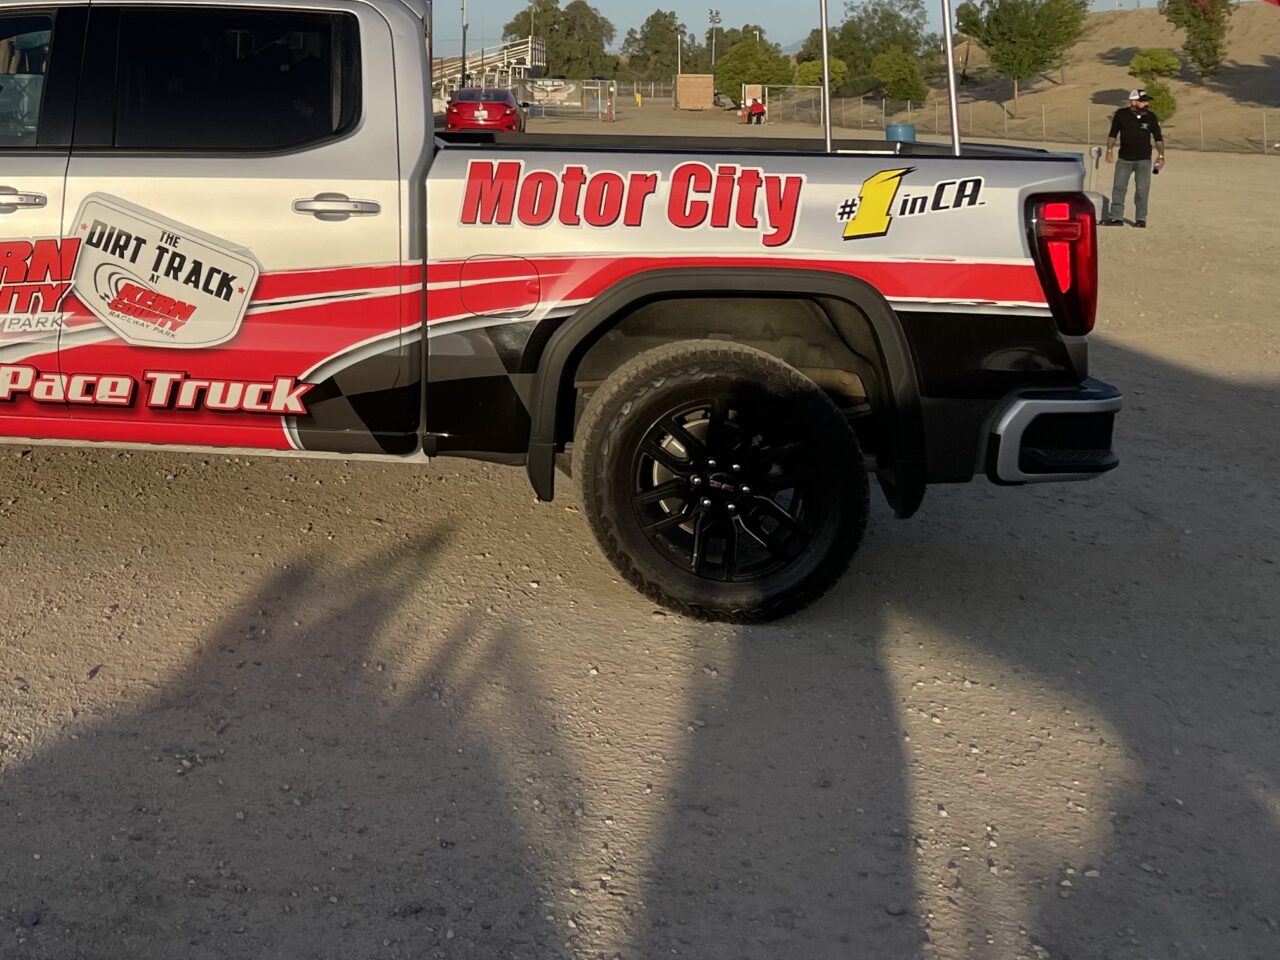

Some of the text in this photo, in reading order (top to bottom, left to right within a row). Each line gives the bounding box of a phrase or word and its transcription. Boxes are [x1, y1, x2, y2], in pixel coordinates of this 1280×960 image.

[460, 161, 803, 247] Motor City
[898, 194, 928, 216] in
[159, 231, 181, 248] THE
[85, 219, 238, 302] DIRT TRACK
[148, 273, 161, 284] AT
[107, 298, 187, 332] COUNTY
[116, 283, 197, 322] KERN
[7, 315, 63, 329] PARK
[108, 311, 177, 339] RACEWAY PARK
[143, 369, 314, 415] Truck
